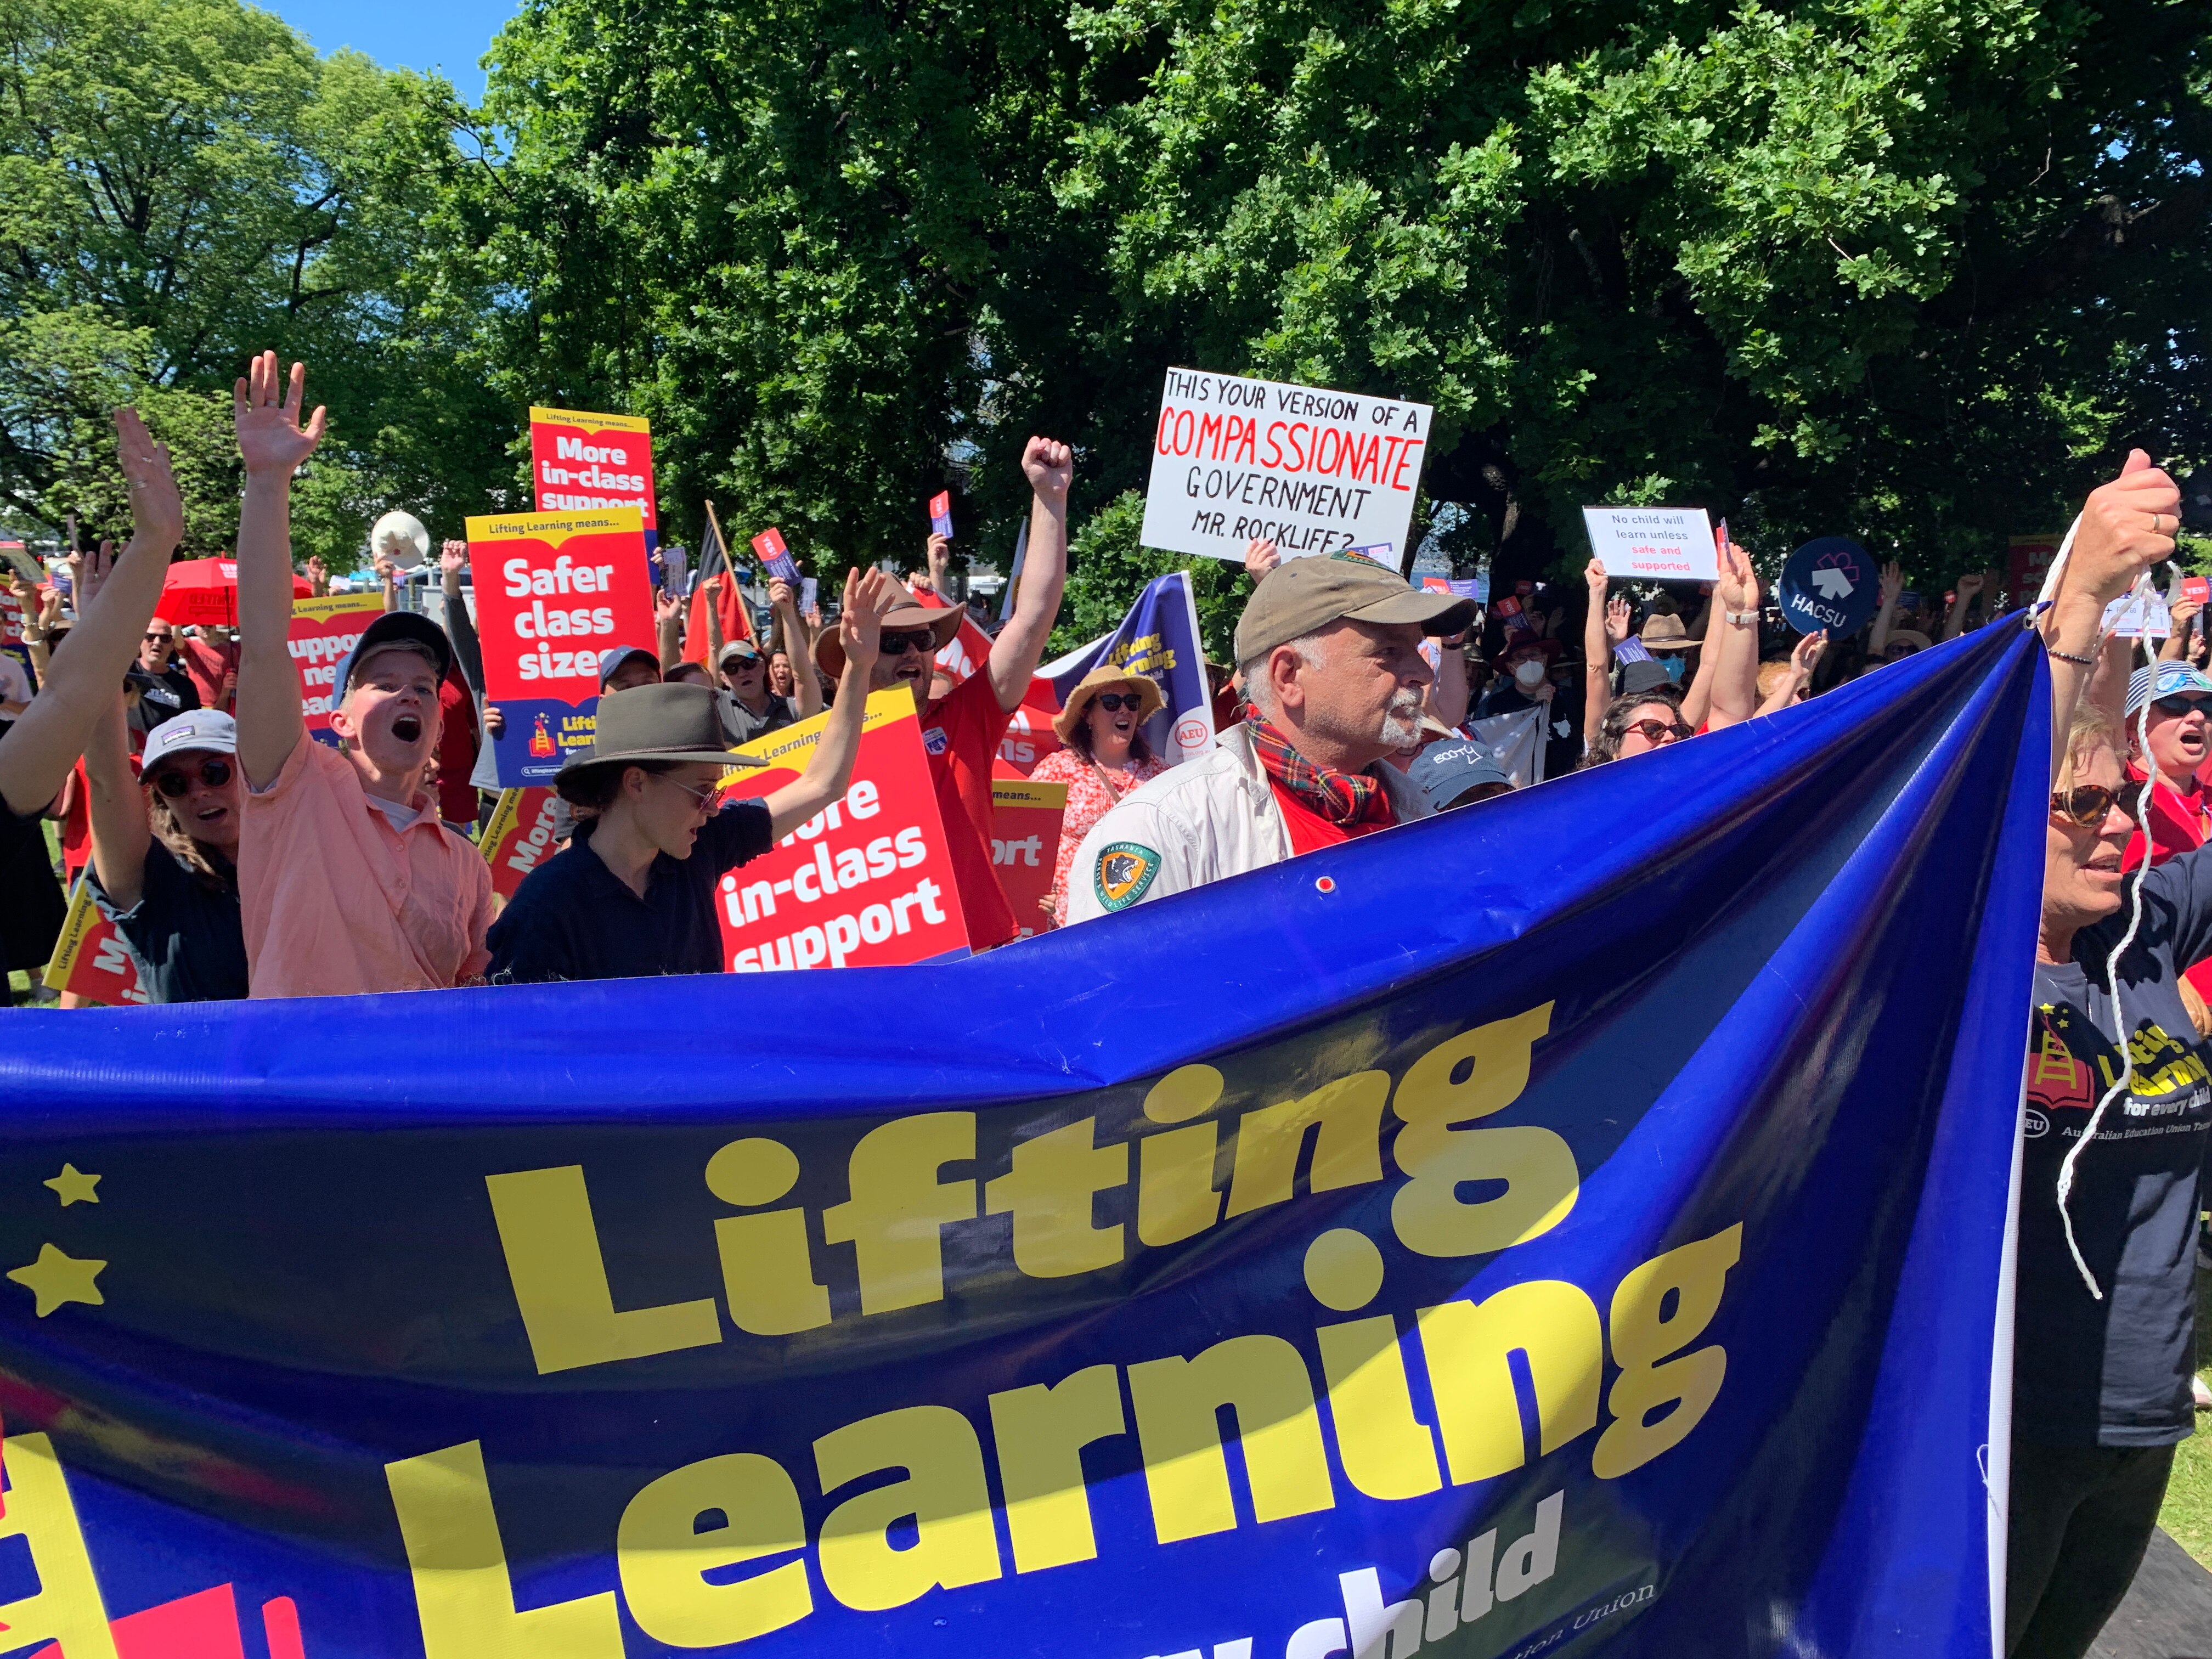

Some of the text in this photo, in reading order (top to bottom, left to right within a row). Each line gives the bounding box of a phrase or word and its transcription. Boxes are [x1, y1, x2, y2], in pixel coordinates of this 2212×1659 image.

[1169, 371, 1417, 433] THIS YOUR VERSION OF A
[546, 413, 571, 424] Lifting
[572, 416, 603, 426] Learning
[556, 436, 627, 466] More
[1158, 406, 1424, 491] COMPASSIONATE
[541, 460, 645, 492] in-class
[1186, 466, 1372, 520] GOVERNMENT
[489, 518, 619, 534] Lifting Learning means...
[1192, 510, 1224, 537] MR.
[1612, 515, 1684, 525] No child will
[1616, 529, 1689, 540] learn unless
[763, 535, 778, 557] YES!
[1632, 545, 1681, 555] safe and
[503, 555, 613, 597] Safer
[1632, 561, 1691, 572] supported
[2186, 586, 2207, 595] YES!
[298, 603, 335, 612] Learning
[515, 600, 615, 639] class
[1791, 593, 1847, 628] HACSU
[763, 730, 822, 760] Learning
[1180, 728, 1204, 741] AEU
[491, 804, 513, 839] Learning
[507, 797, 558, 874] More
[1107, 844, 1143, 855] TASMANIA
[722, 826, 927, 928] in-class
[1099, 890, 1132, 908] WILDLIFE
[1132, 862, 1154, 895] SERVICE
[58, 899, 92, 969] Lifting Learning
[734, 877, 946, 973] support
[2123, 1097, 2149, 1117] for
[2151, 1099, 2188, 1116] every
[2062, 1126, 2123, 1140] Auralian
[2124, 1126, 2164, 1139] Education
[2165, 1124, 2191, 1134] Union
[485, 999, 1580, 1375] Lifting
[384, 1221, 1743, 1659] Learning
[1572, 1584, 1654, 1630] Union
